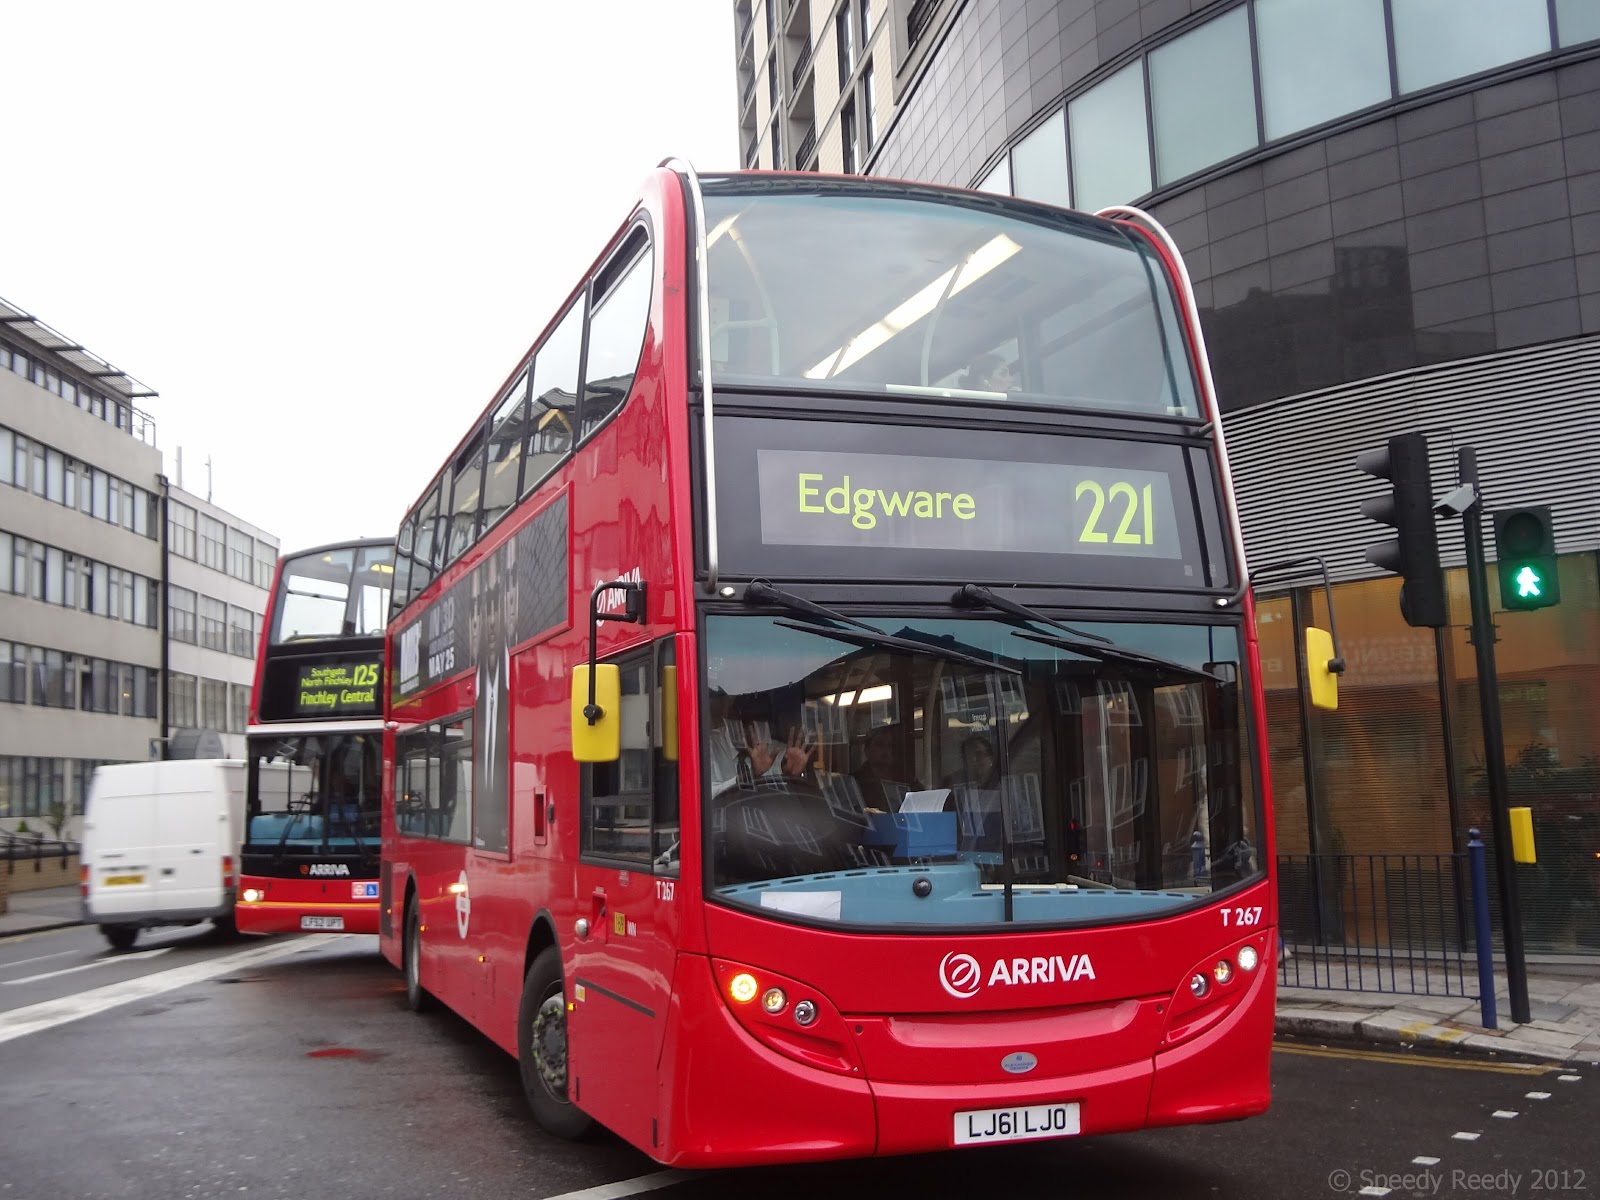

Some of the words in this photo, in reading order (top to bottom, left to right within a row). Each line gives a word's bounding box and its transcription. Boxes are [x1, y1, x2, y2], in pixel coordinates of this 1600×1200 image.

[799, 472, 976, 530] Edgware
[1075, 479, 1153, 545] 221
[311, 667, 346, 678] Southgate
[428, 651, 446, 679] MAY
[445, 646, 455, 671] 25
[301, 678, 322, 687] North
[323, 676, 353, 686] Finchley
[353, 663, 379, 686] 125
[300, 690, 338, 708] Finchley
[340, 688, 375, 704] Central
[309, 864, 350, 876] ARRIVA
[656, 881, 661, 899] T
[662, 882, 675, 901] 267
[1220, 908, 1231, 926] T
[1235, 907, 1262, 926] 267
[988, 954, 1096, 987] ARRIVA
[969, 1112, 1017, 1138] LJ61
